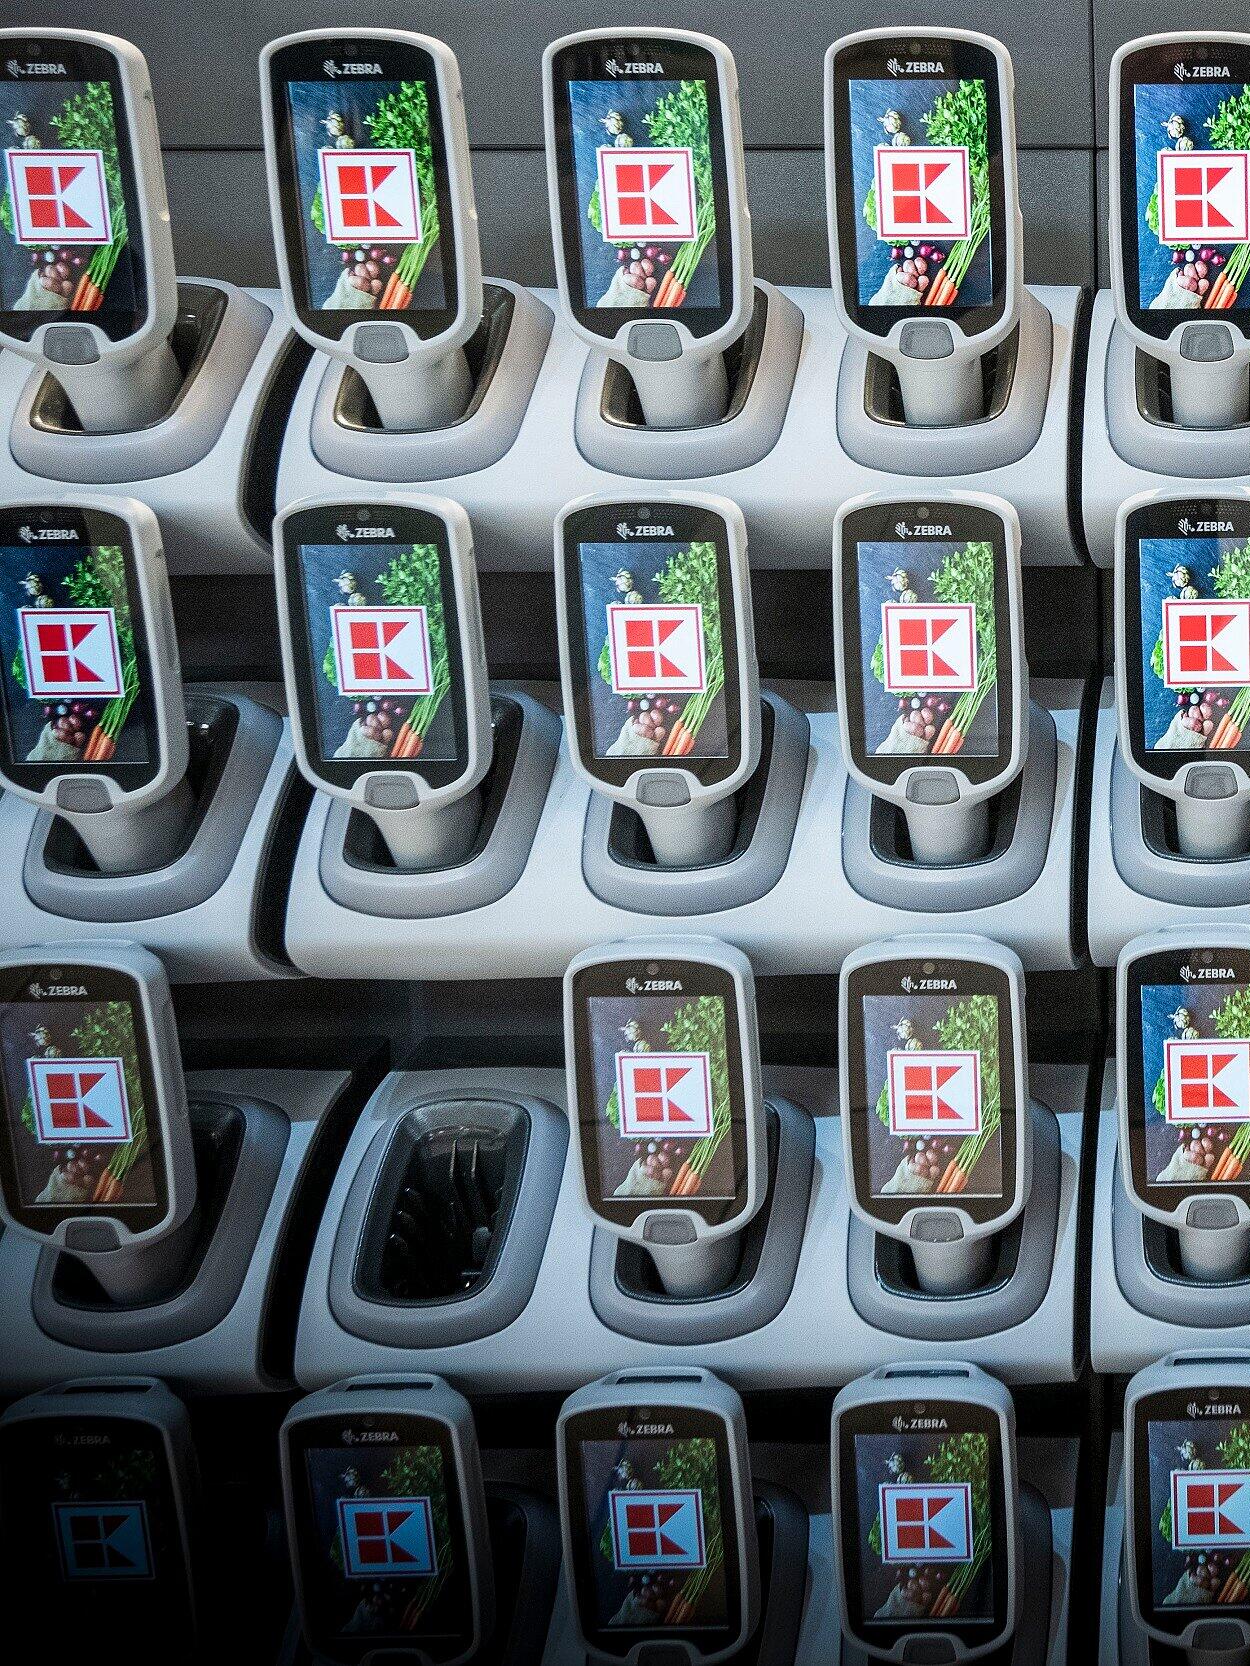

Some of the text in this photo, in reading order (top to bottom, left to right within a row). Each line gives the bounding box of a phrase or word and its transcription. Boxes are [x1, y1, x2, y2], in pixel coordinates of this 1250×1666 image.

[26, 63, 67, 75] ZEBRA
[340, 63, 383, 75] ZEBRA
[621, 62, 664, 74] ZEBRA
[905, 61, 945, 74] ZEBRA
[1191, 66, 1231, 78] ZEBRA
[635, 525, 675, 537] ZEBRA
[913, 525, 952, 536] ZEBRA
[1196, 520, 1235, 532] ZEBRA
[38, 529, 79, 540] ZEBRA
[353, 527, 395, 539] ZEBRA
[1196, 968, 1236, 979] ZEBRA
[642, 980, 683, 991] ZEBRA
[919, 979, 958, 990] ZEBRA
[46, 985, 88, 996] ZEBRA
[1204, 1404, 1242, 1415] ZEBRA
[910, 1418, 948, 1429] ZEBRA
[634, 1424, 674, 1435] ZEBRA
[361, 1431, 399, 1442] ZEBRA
